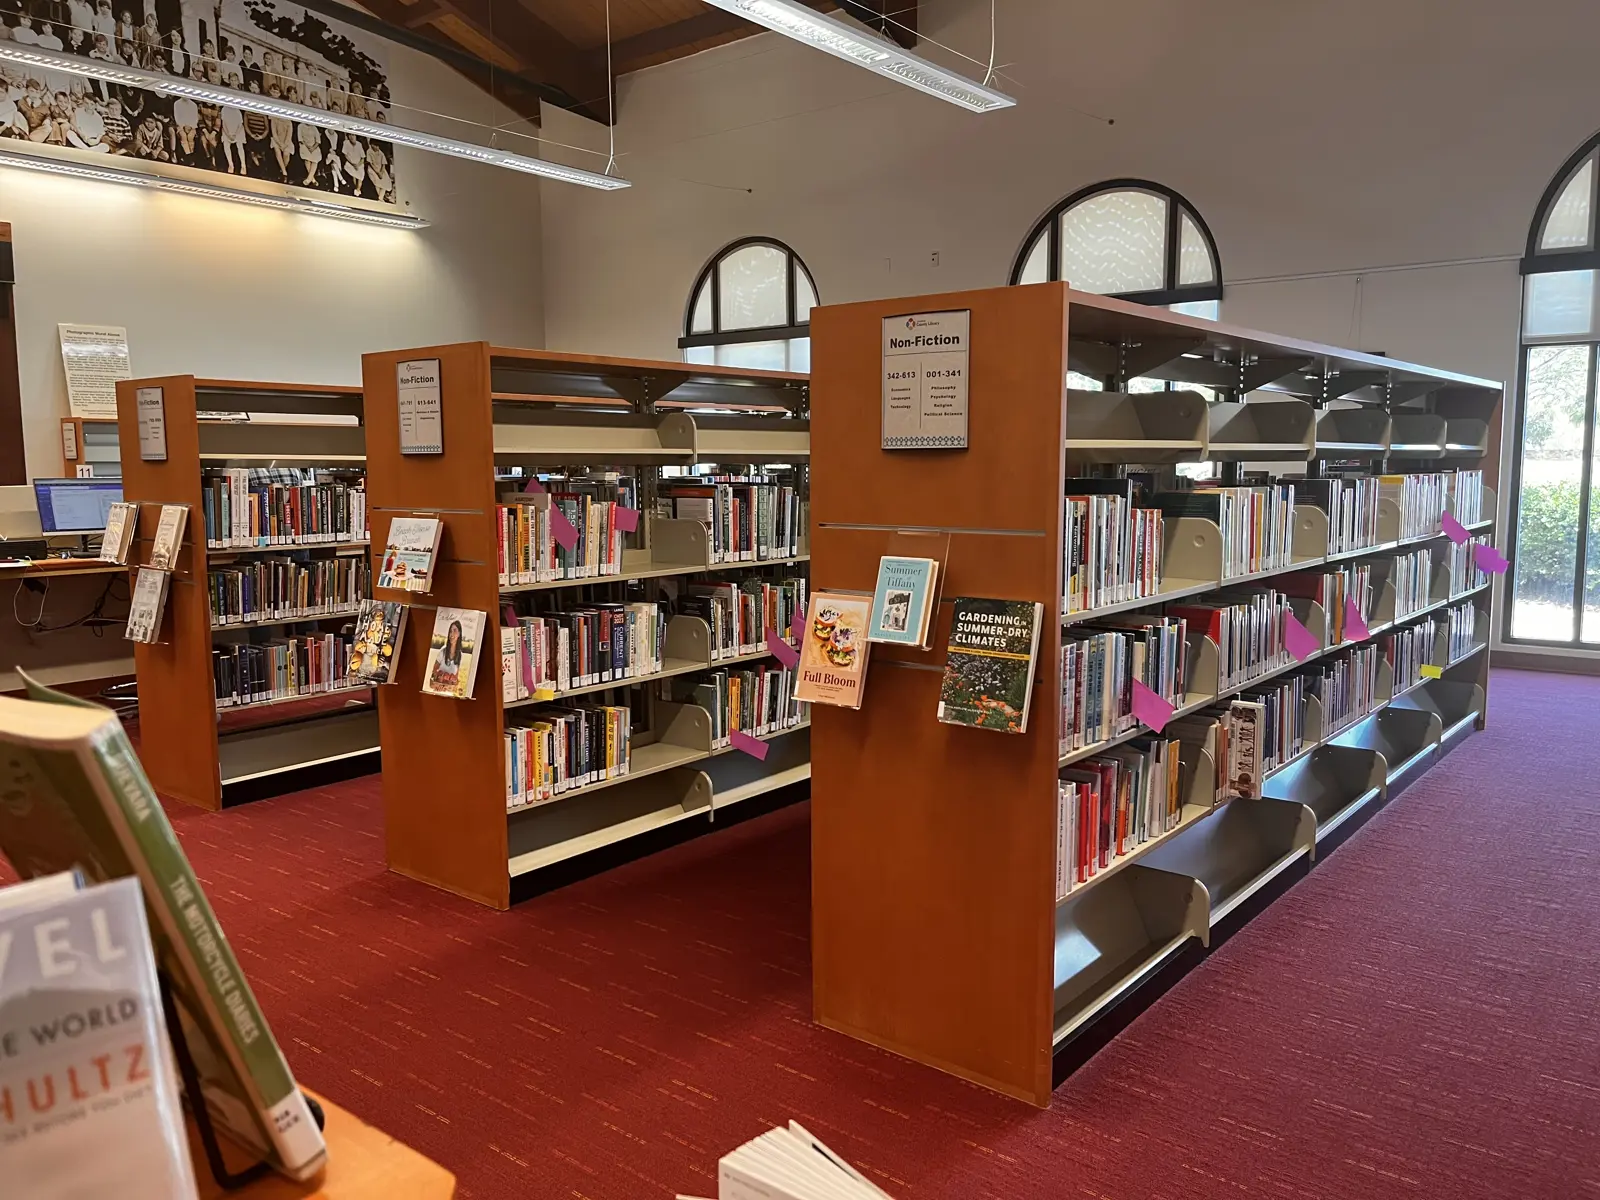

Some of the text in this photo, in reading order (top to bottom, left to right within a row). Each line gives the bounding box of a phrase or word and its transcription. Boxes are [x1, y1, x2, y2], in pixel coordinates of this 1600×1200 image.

[890, 334, 960, 349] Non-Fiction
[400, 375, 435, 384] Non-Fiction
[887, 371, 916, 380] 342-613
[926, 369, 961, 378] 001-341
[79, 467, 91, 478] 11
[884, 563, 923, 576] Summer
[886, 576, 916, 591] Tiffany
[958, 611, 1020, 626] GARDENING
[361, 618, 392, 635] HOME
[956, 622, 1028, 638] SUMMER-DRY
[955, 633, 1007, 648] CLIMATES
[803, 670, 822, 683] Full
[824, 673, 857, 688] Bloom
[114, 752, 153, 823] UEVARA
[170, 874, 261, 1045] THE MOTORCYCLE DIARIES
[29, 998, 138, 1047] WORLD
